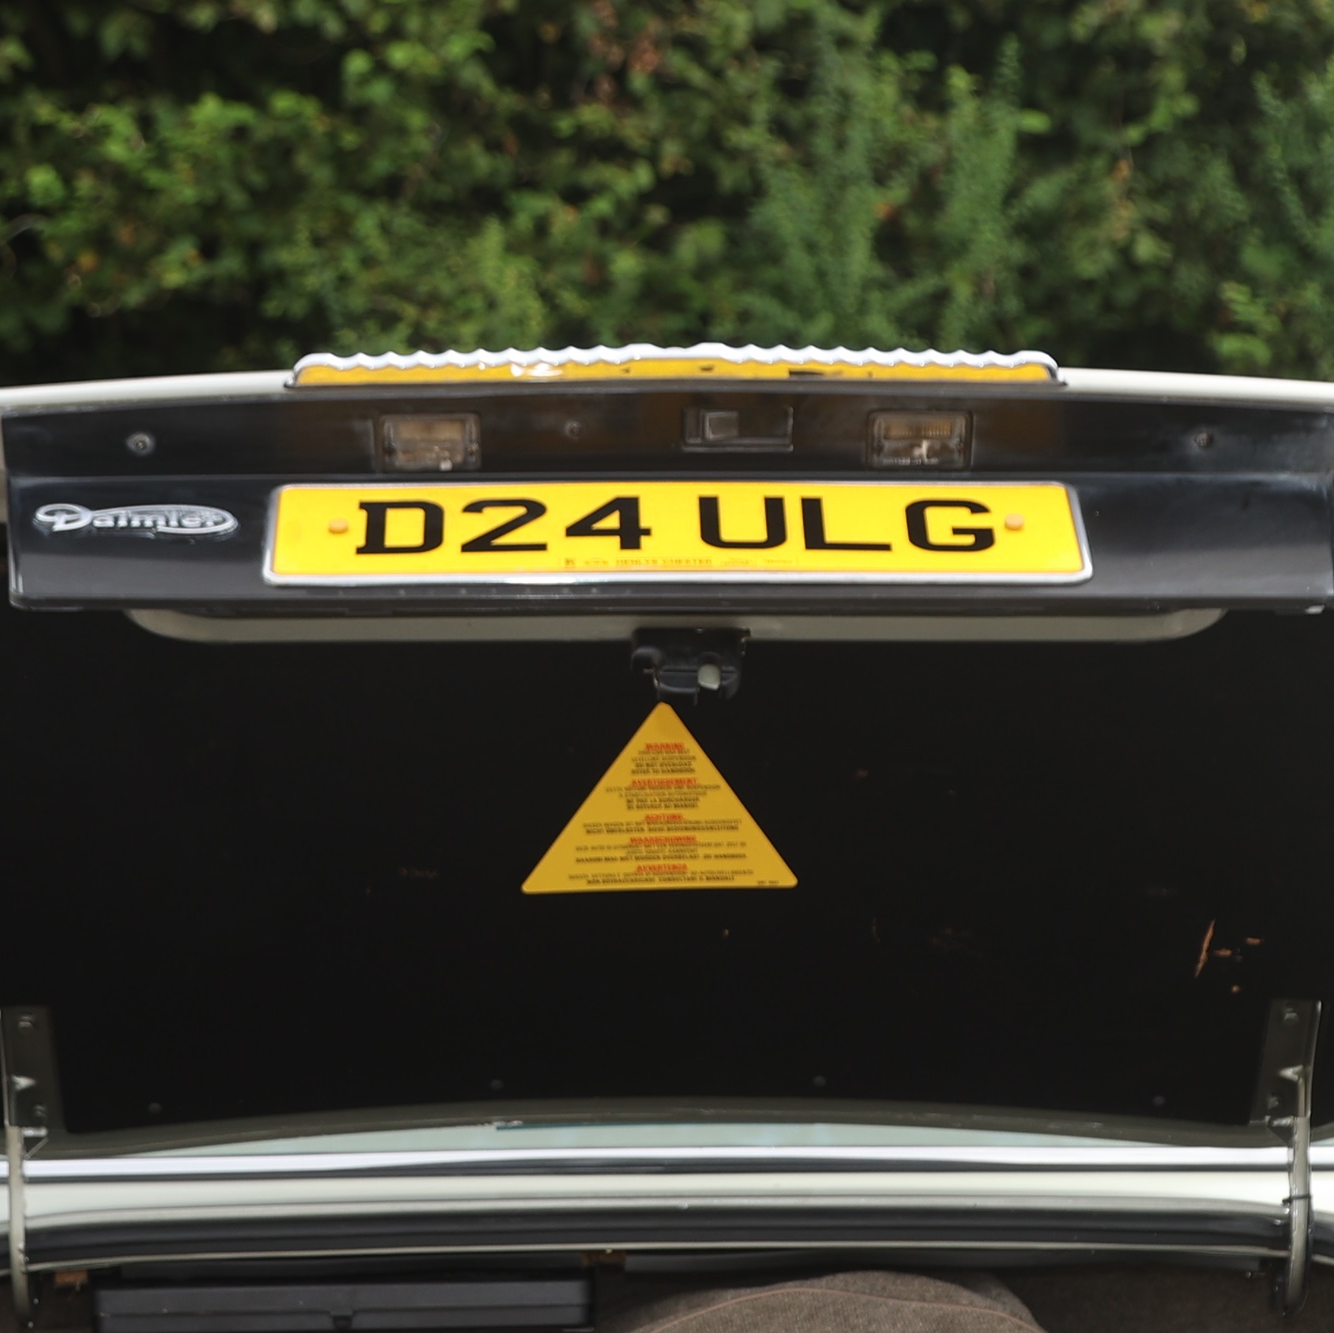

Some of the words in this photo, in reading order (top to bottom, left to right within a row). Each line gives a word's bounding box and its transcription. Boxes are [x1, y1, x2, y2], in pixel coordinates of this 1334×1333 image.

[35, 502, 240, 535] Daimler
[354, 496, 652, 555] D24
[697, 495, 997, 553] ULG
